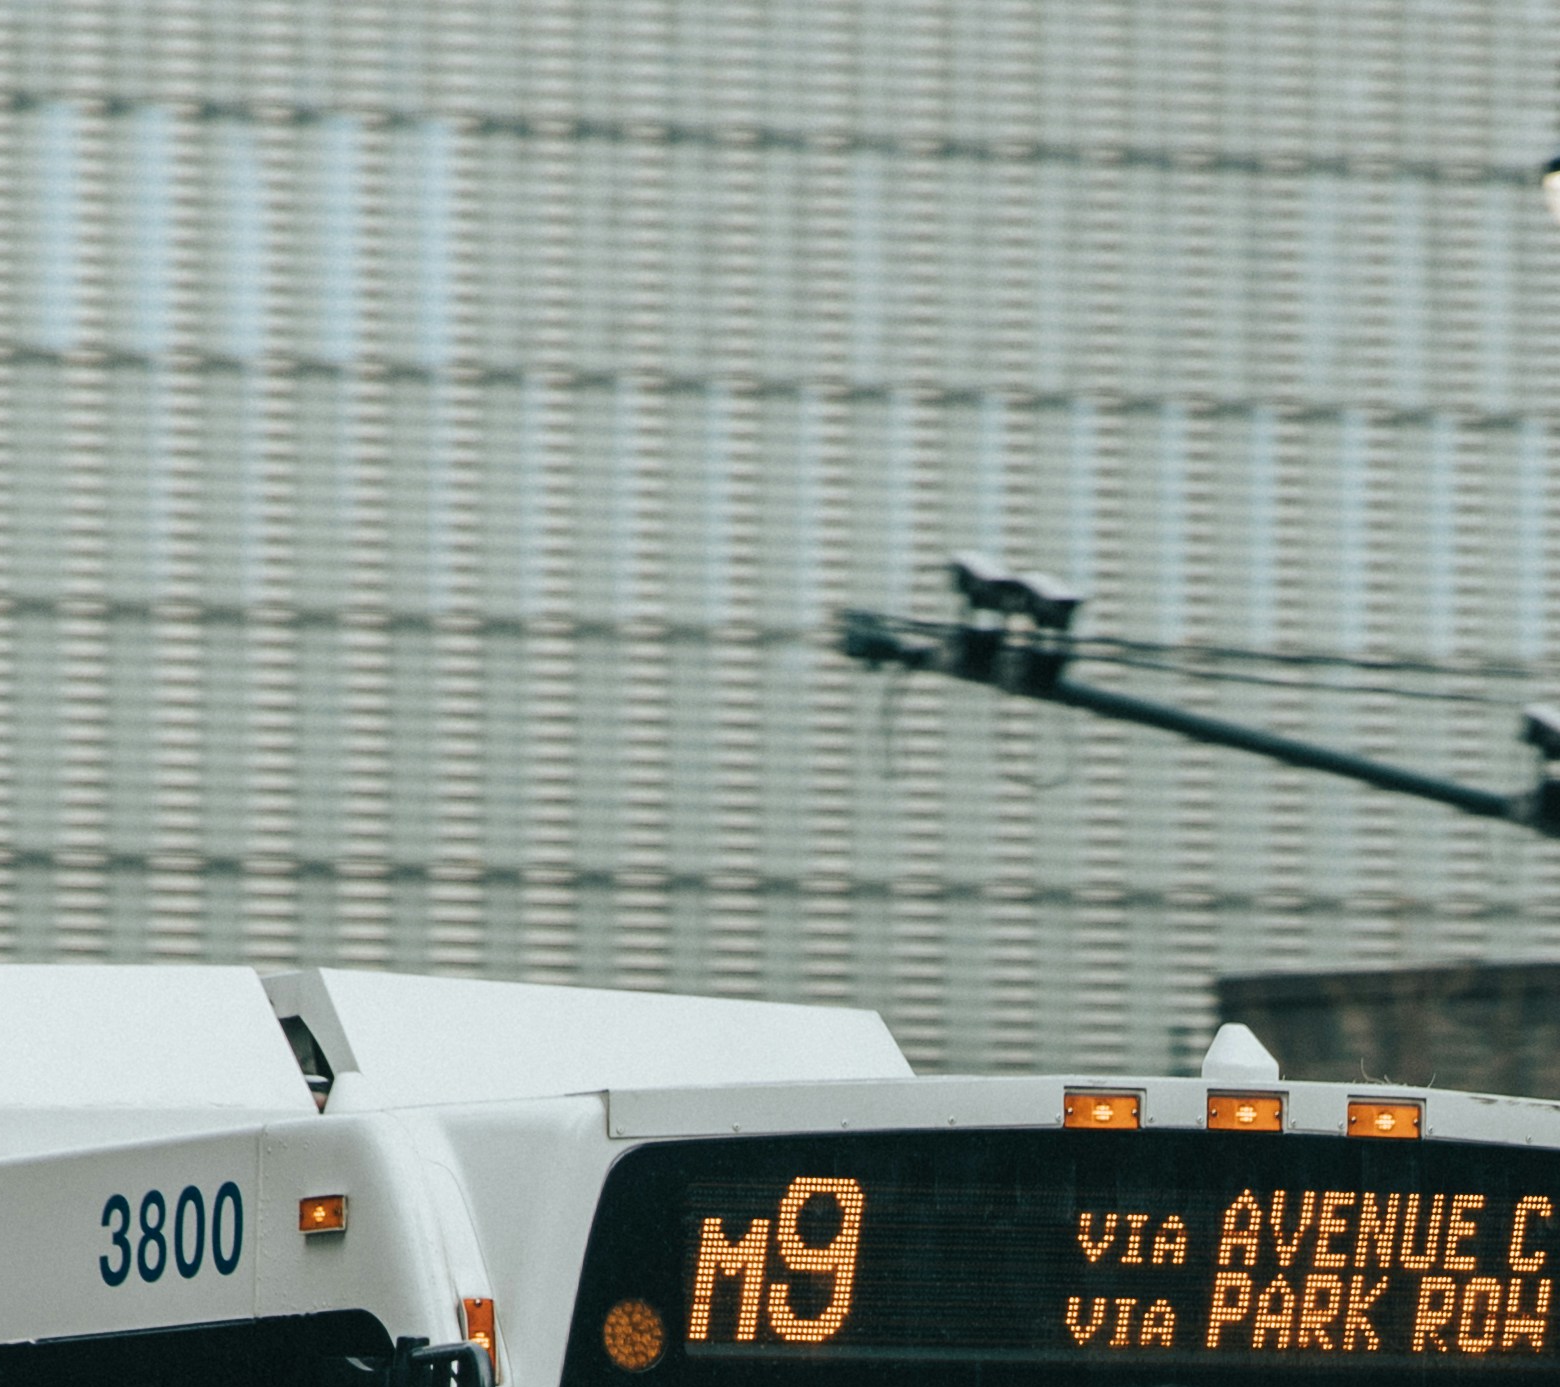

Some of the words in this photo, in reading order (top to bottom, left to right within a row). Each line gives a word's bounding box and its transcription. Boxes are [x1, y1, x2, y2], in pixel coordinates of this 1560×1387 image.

[98, 1181, 244, 1289] 3800
[688, 1175, 864, 1344] M9
[1077, 1210, 1187, 1267] VIA
[1219, 1188, 1485, 1272] AVENUE
[1506, 1194, 1553, 1274] C
[1065, 1295, 1175, 1347] VIA
[1205, 1273, 1388, 1354] PARK
[1412, 1276, 1551, 1354] ROW
